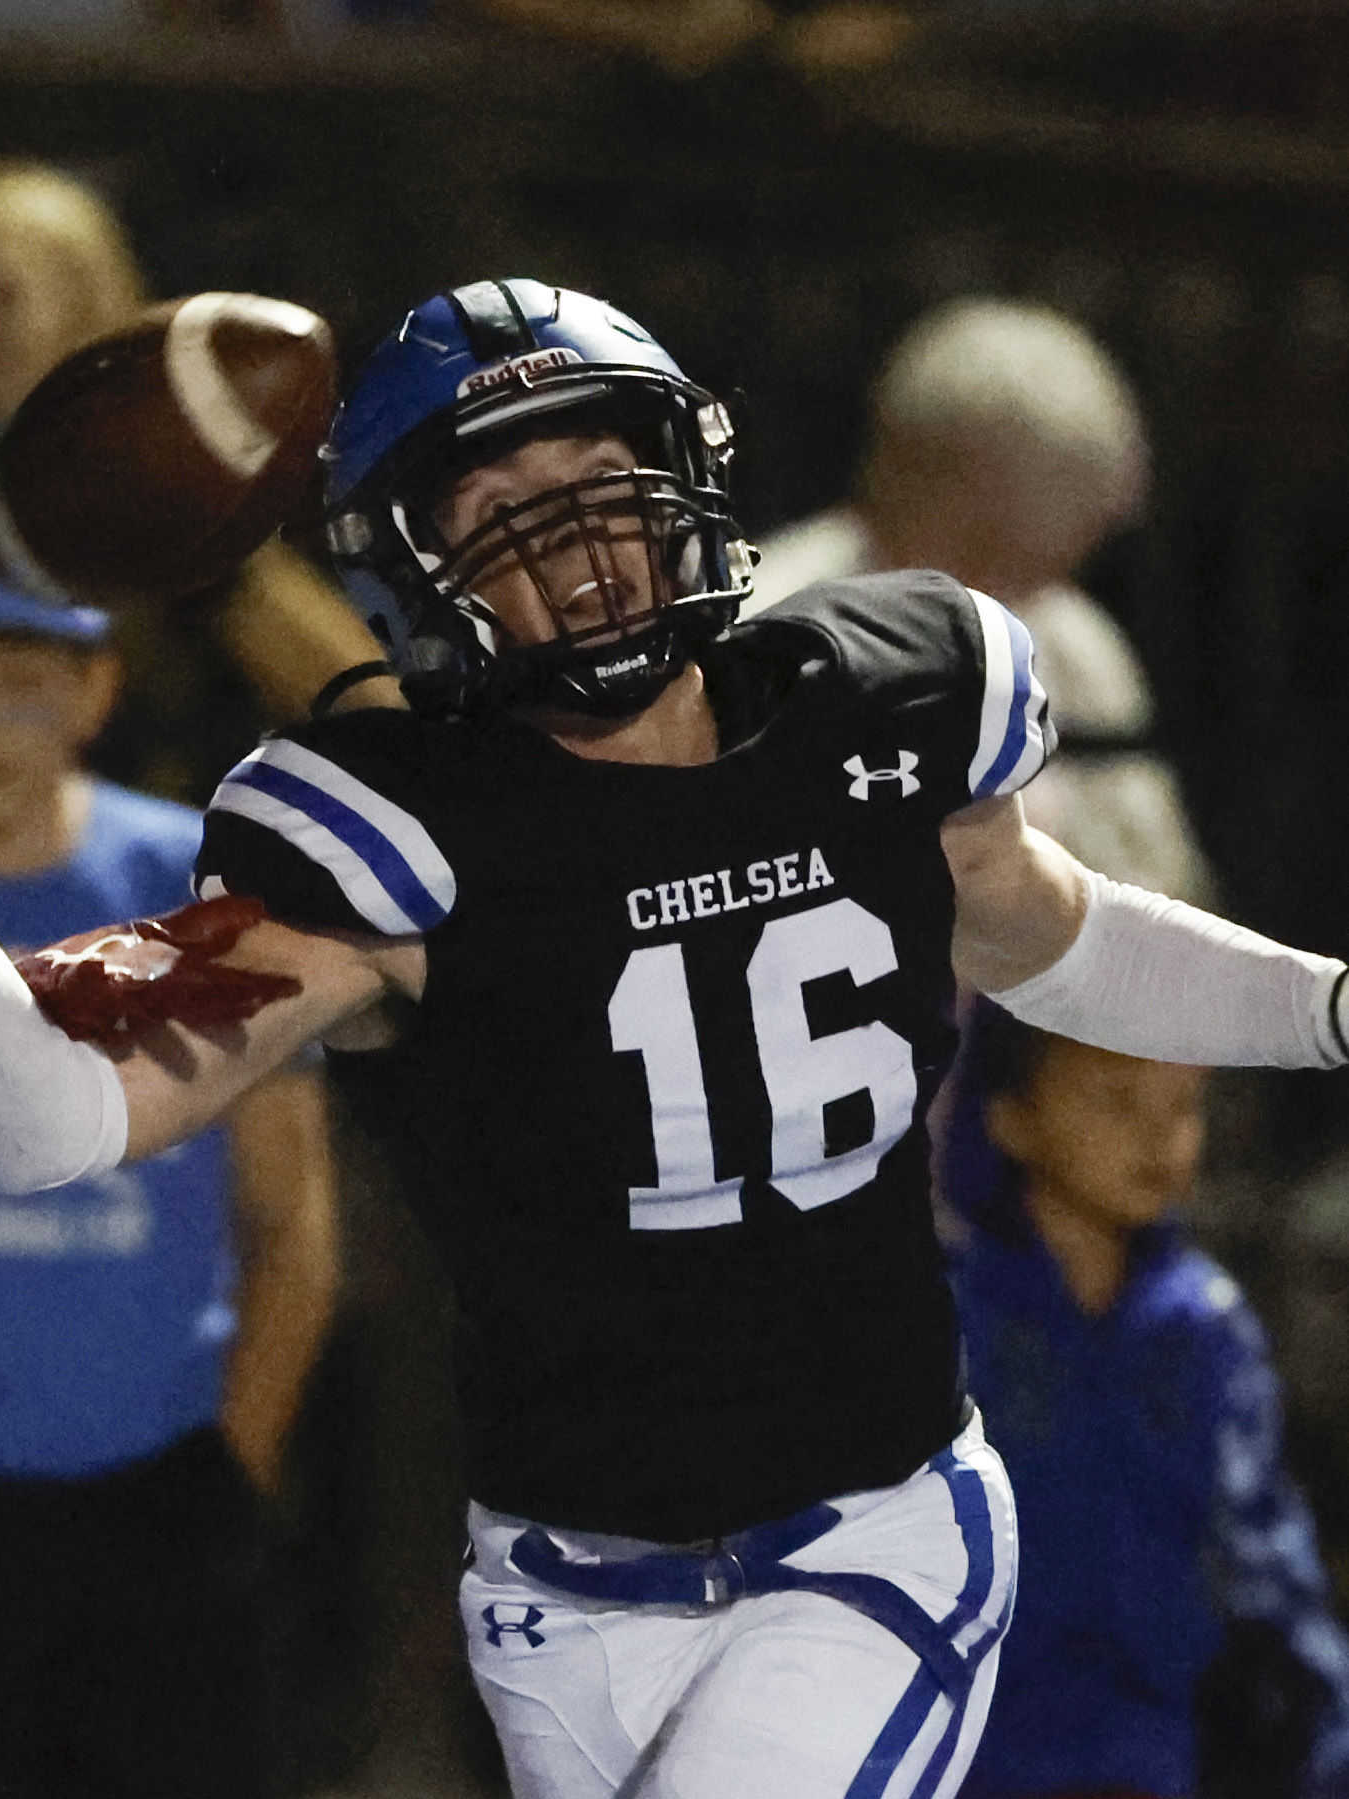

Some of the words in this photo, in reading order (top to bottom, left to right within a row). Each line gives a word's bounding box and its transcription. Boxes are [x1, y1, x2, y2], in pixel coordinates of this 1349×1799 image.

[594, 653, 649, 679] Riddell
[625, 847, 835, 931] CHELSEA
[607, 897, 919, 1231] 16
